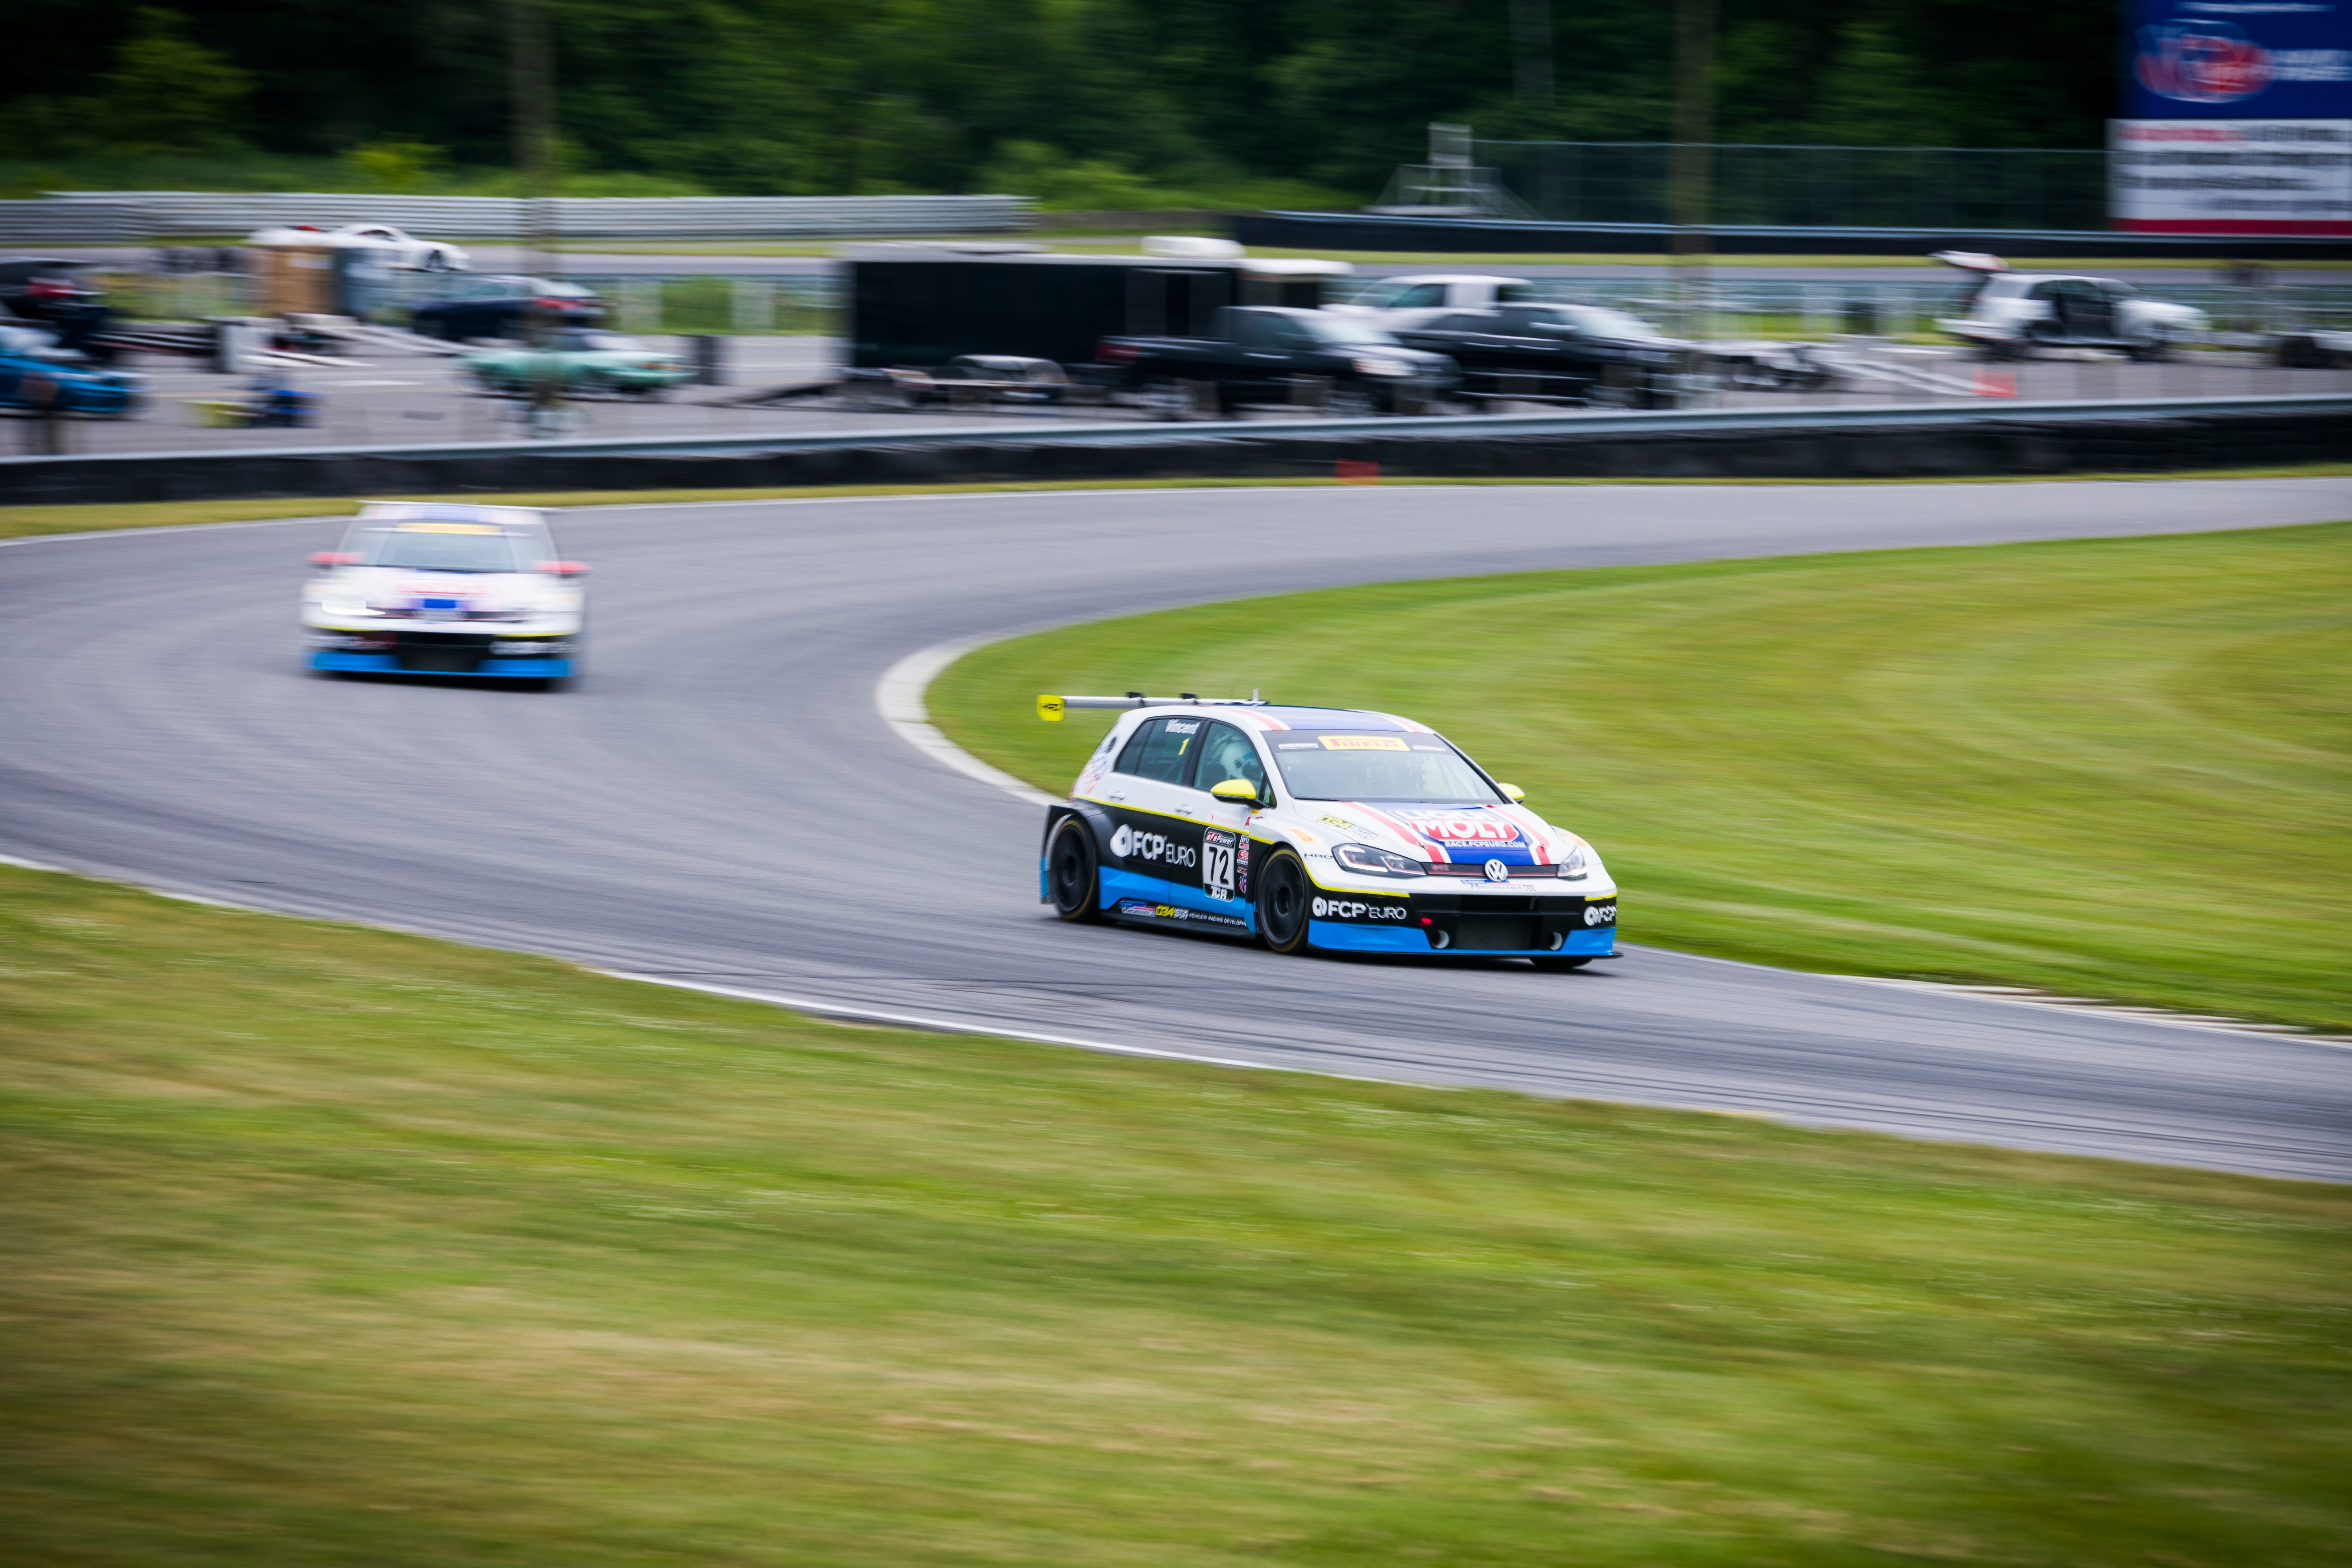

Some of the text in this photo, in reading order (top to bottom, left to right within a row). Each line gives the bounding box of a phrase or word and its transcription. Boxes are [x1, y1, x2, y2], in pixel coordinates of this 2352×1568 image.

[1178, 738, 1190, 755] 1
[1329, 739, 1399, 748] PIRELLI
[1214, 816, 1239, 827] CROWDSTRIKE
[1415, 820, 1508, 839] MOLY
[1132, 830, 1196, 867] FCP EURO
[1209, 846, 1229, 885] 72
[1211, 886, 1227, 900] TCR
[1156, 905, 1175, 918] 034
[1189, 912, 1207, 920] HEINLEIN
[1328, 899, 1407, 920] FCP EURO
